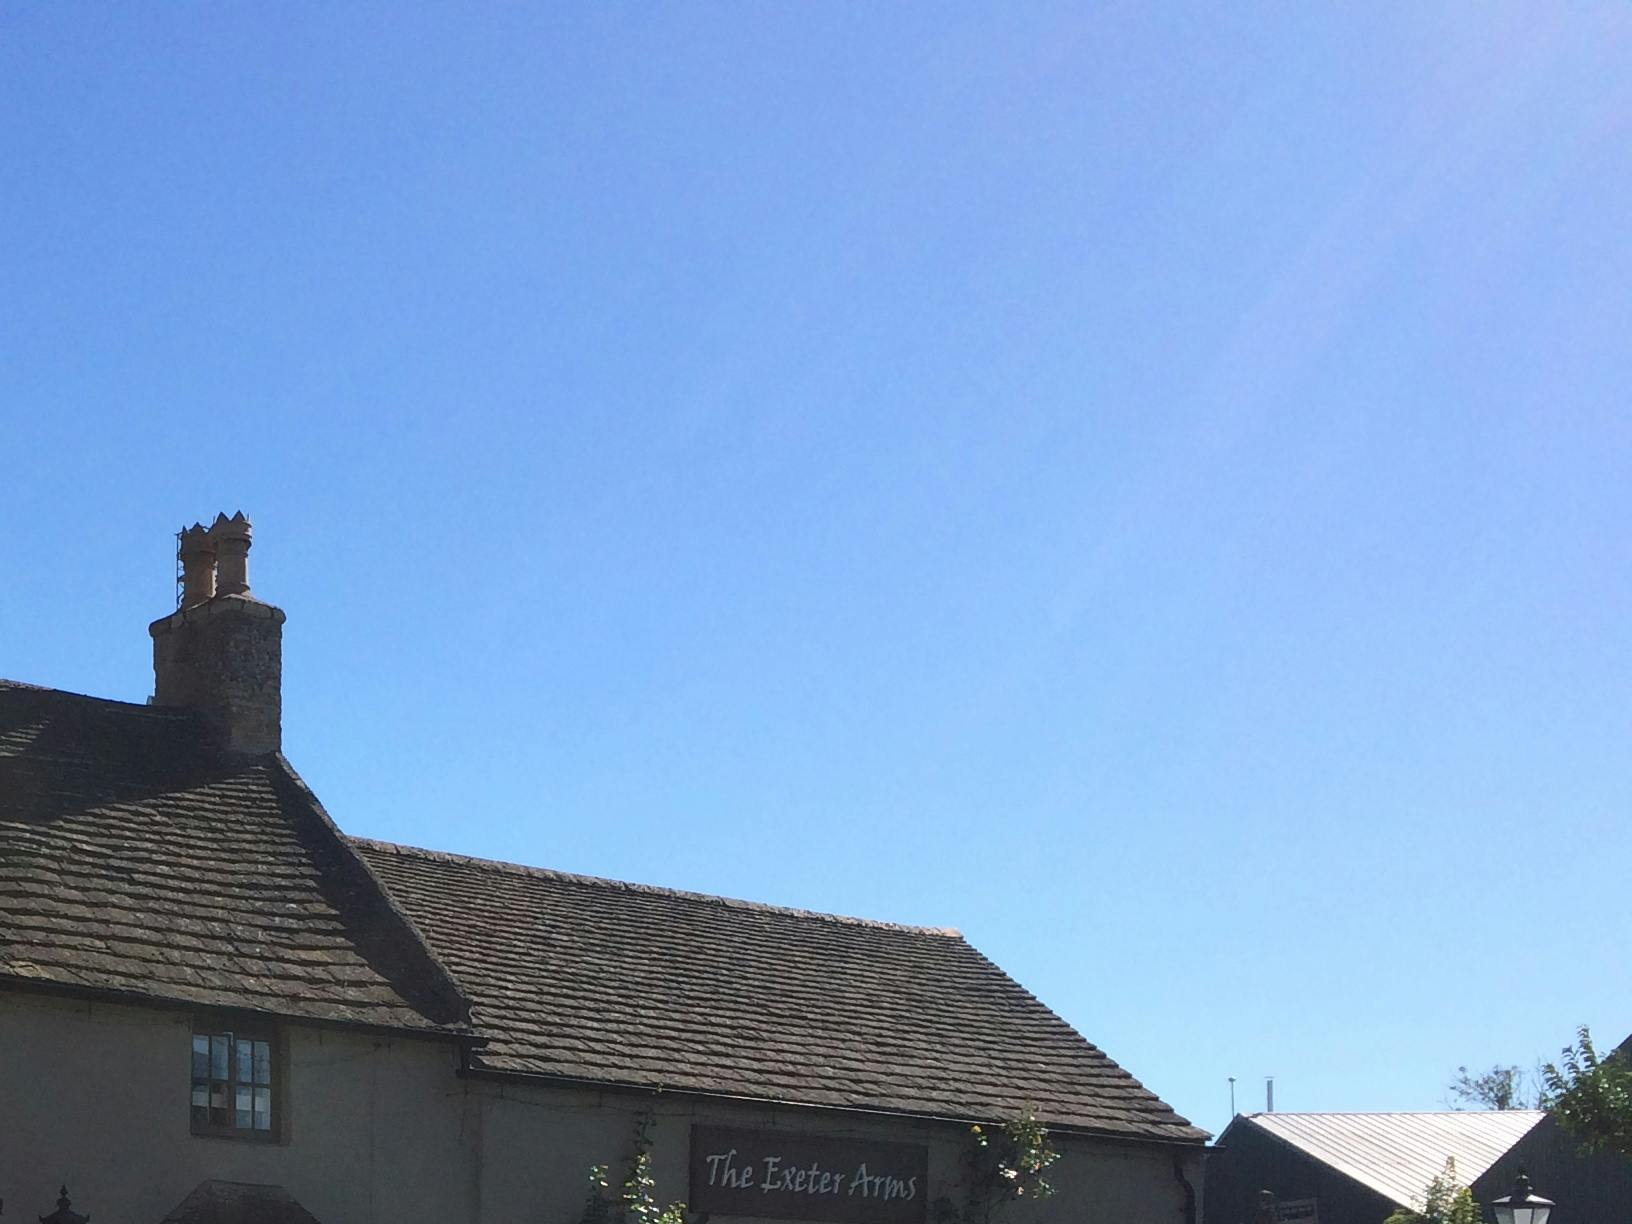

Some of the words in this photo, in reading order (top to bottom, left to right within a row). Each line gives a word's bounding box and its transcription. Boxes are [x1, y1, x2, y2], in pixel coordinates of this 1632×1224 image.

[706, 1149, 754, 1189] The
[761, 1155, 846, 1194] Exeter
[848, 1163, 917, 1201] Arms
